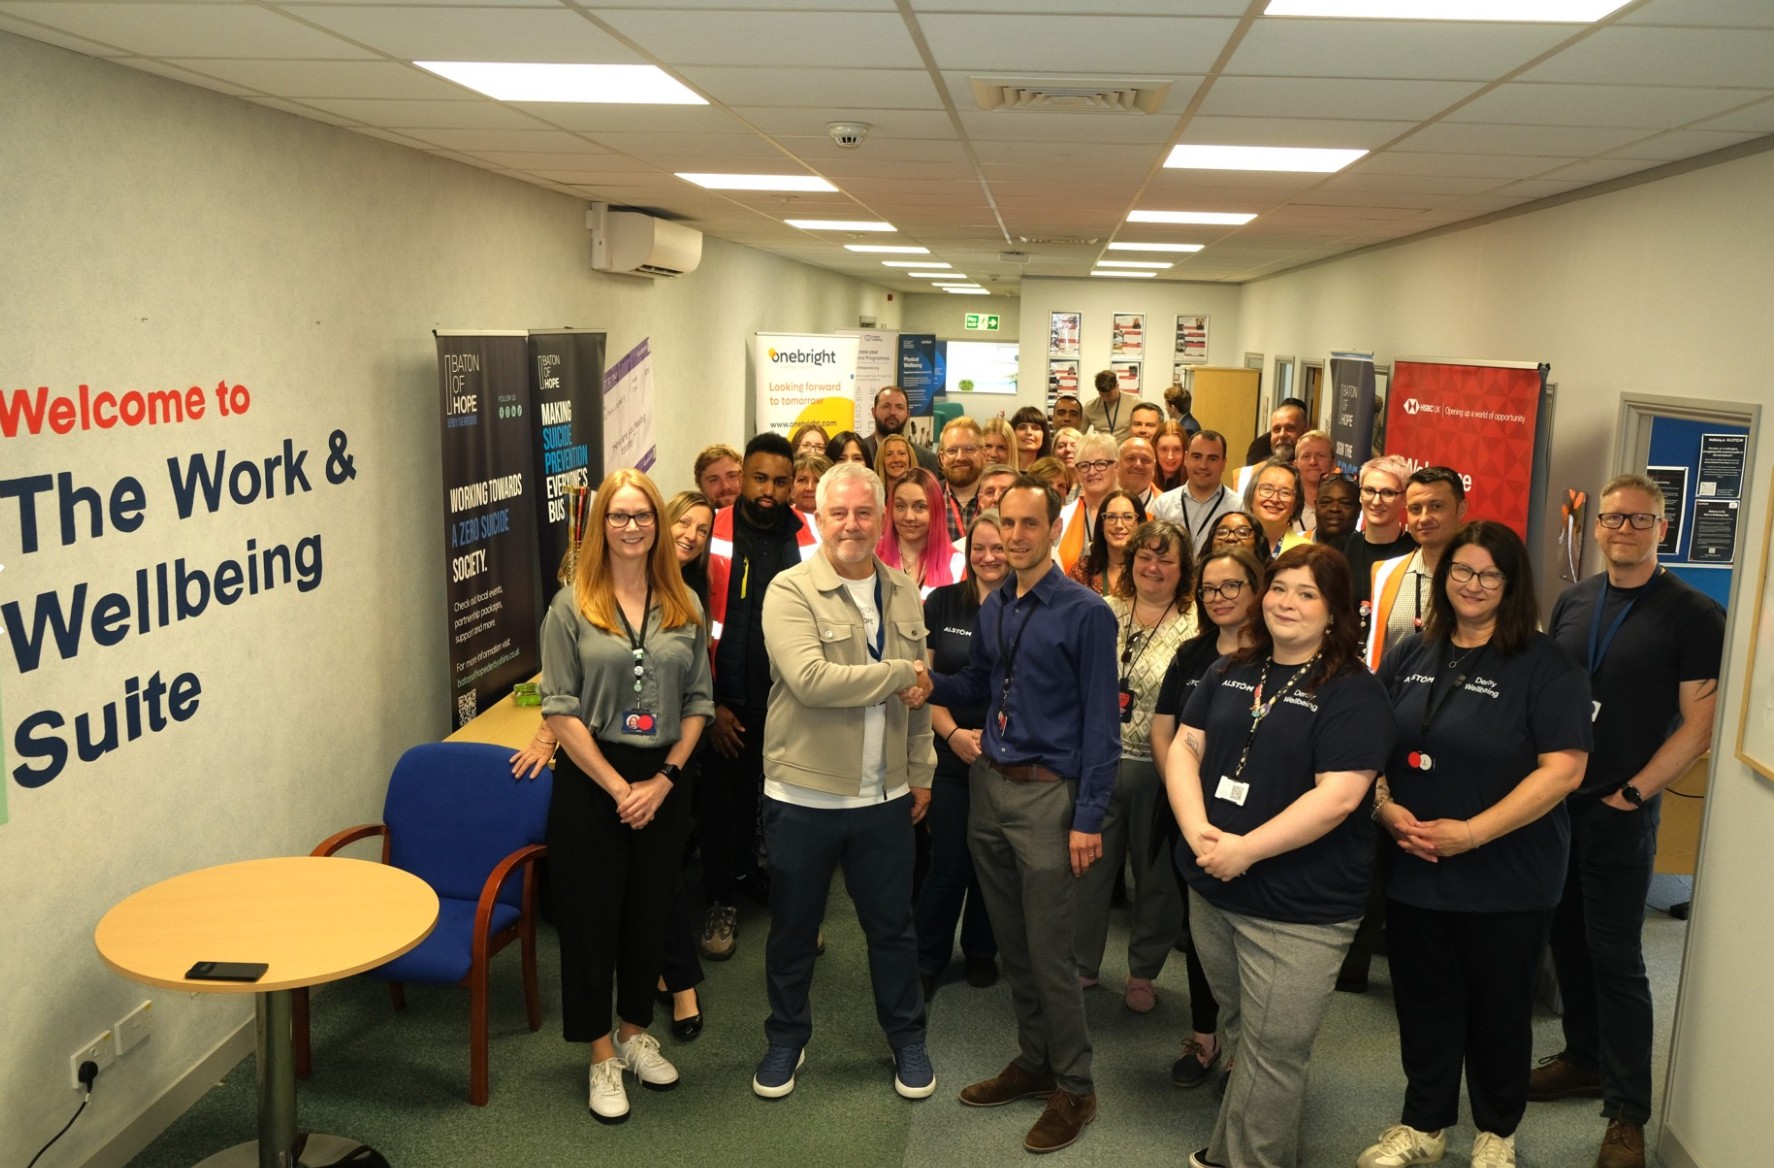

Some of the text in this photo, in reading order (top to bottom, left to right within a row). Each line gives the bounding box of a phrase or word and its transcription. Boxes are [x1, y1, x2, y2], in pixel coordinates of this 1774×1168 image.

[451, 354, 480, 373] BATON
[542, 354, 560, 366] BATON
[771, 348, 836, 366] onebright
[543, 366, 551, 378] OF
[452, 375, 465, 394] OF
[544, 378, 560, 390] HOPE
[769, 382, 841, 393] Looking forward
[0, 379, 251, 438] Welcome to
[453, 395, 478, 415] HOPE
[770, 397, 825, 406] to tomorrow
[541, 400, 572, 427] MAKING
[1420, 404, 1434, 413] HSBC
[1434, 405, 1441, 413] UK
[1445, 406, 1464, 418] Opening
[1475, 411, 1488, 419] world
[1488, 411, 1495, 419] of
[1494, 413, 1526, 424] opportunity
[543, 424, 573, 451] SUICIDE
[544, 444, 588, 475] PREVENTION
[0, 428, 357, 554] The Work &
[450, 473, 523, 514] WORKING TOWARDS
[548, 498, 566, 523] BUS
[452, 508, 510, 549] A ZERO SUICIDE
[452, 548, 488, 583] SOCIETY.
[1, 534, 322, 674] Wellbeing
[454, 599, 471, 612] Check
[477, 590, 489, 602] local
[454, 609, 480, 630] partnership
[455, 628, 474, 644] support
[474, 623, 482, 635] and
[943, 626, 973, 637] ALSTOM
[456, 661, 466, 673] For
[465, 656, 478, 669] more
[477, 643, 502, 661] information
[1221, 679, 1255, 692] ALSTOM
[1403, 673, 1435, 683] ASTOM
[1464, 683, 1500, 699] Wellbeing
[1283, 696, 1319, 712] Wellbeing
[12, 670, 202, 788] Suite
